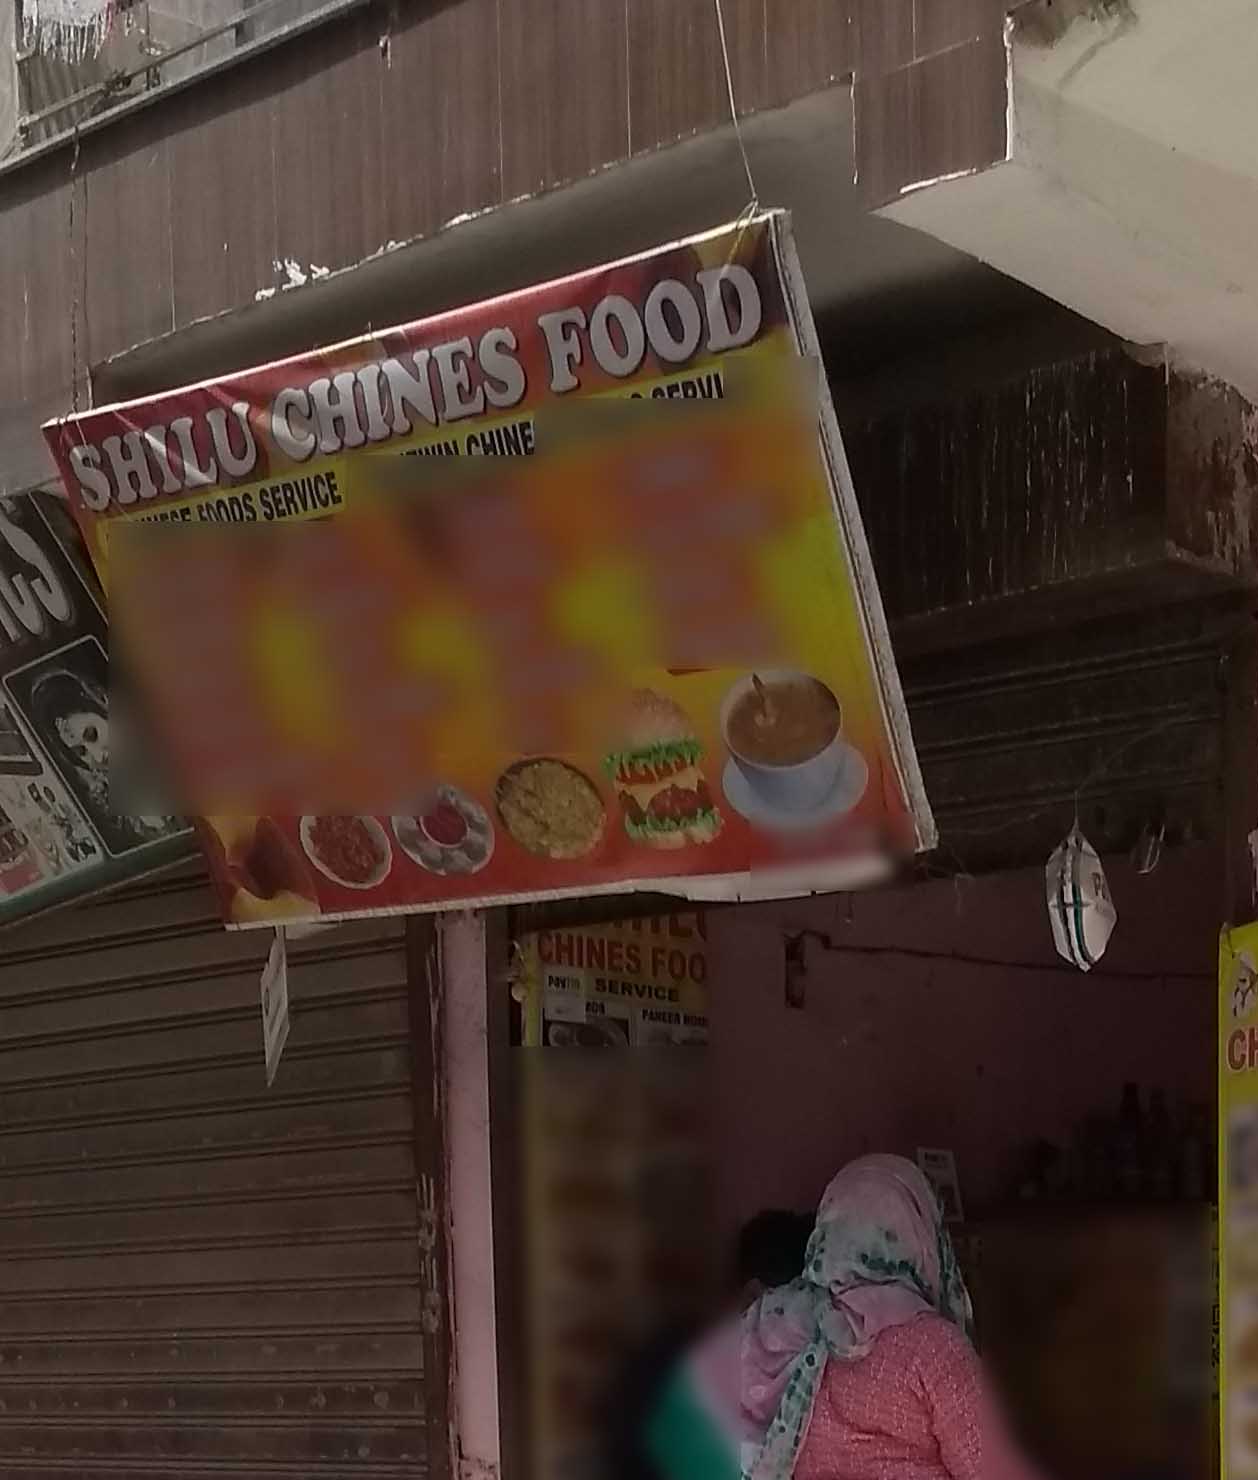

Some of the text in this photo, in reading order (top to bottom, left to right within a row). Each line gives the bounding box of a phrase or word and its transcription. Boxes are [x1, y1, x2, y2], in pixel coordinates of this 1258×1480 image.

[70, 265, 762, 511] SHILU CHINES FOOD
[259, 471, 342, 521] SERVICE
[537, 932, 641, 974] CHINES
[595, 977, 679, 1003] SERVICE
